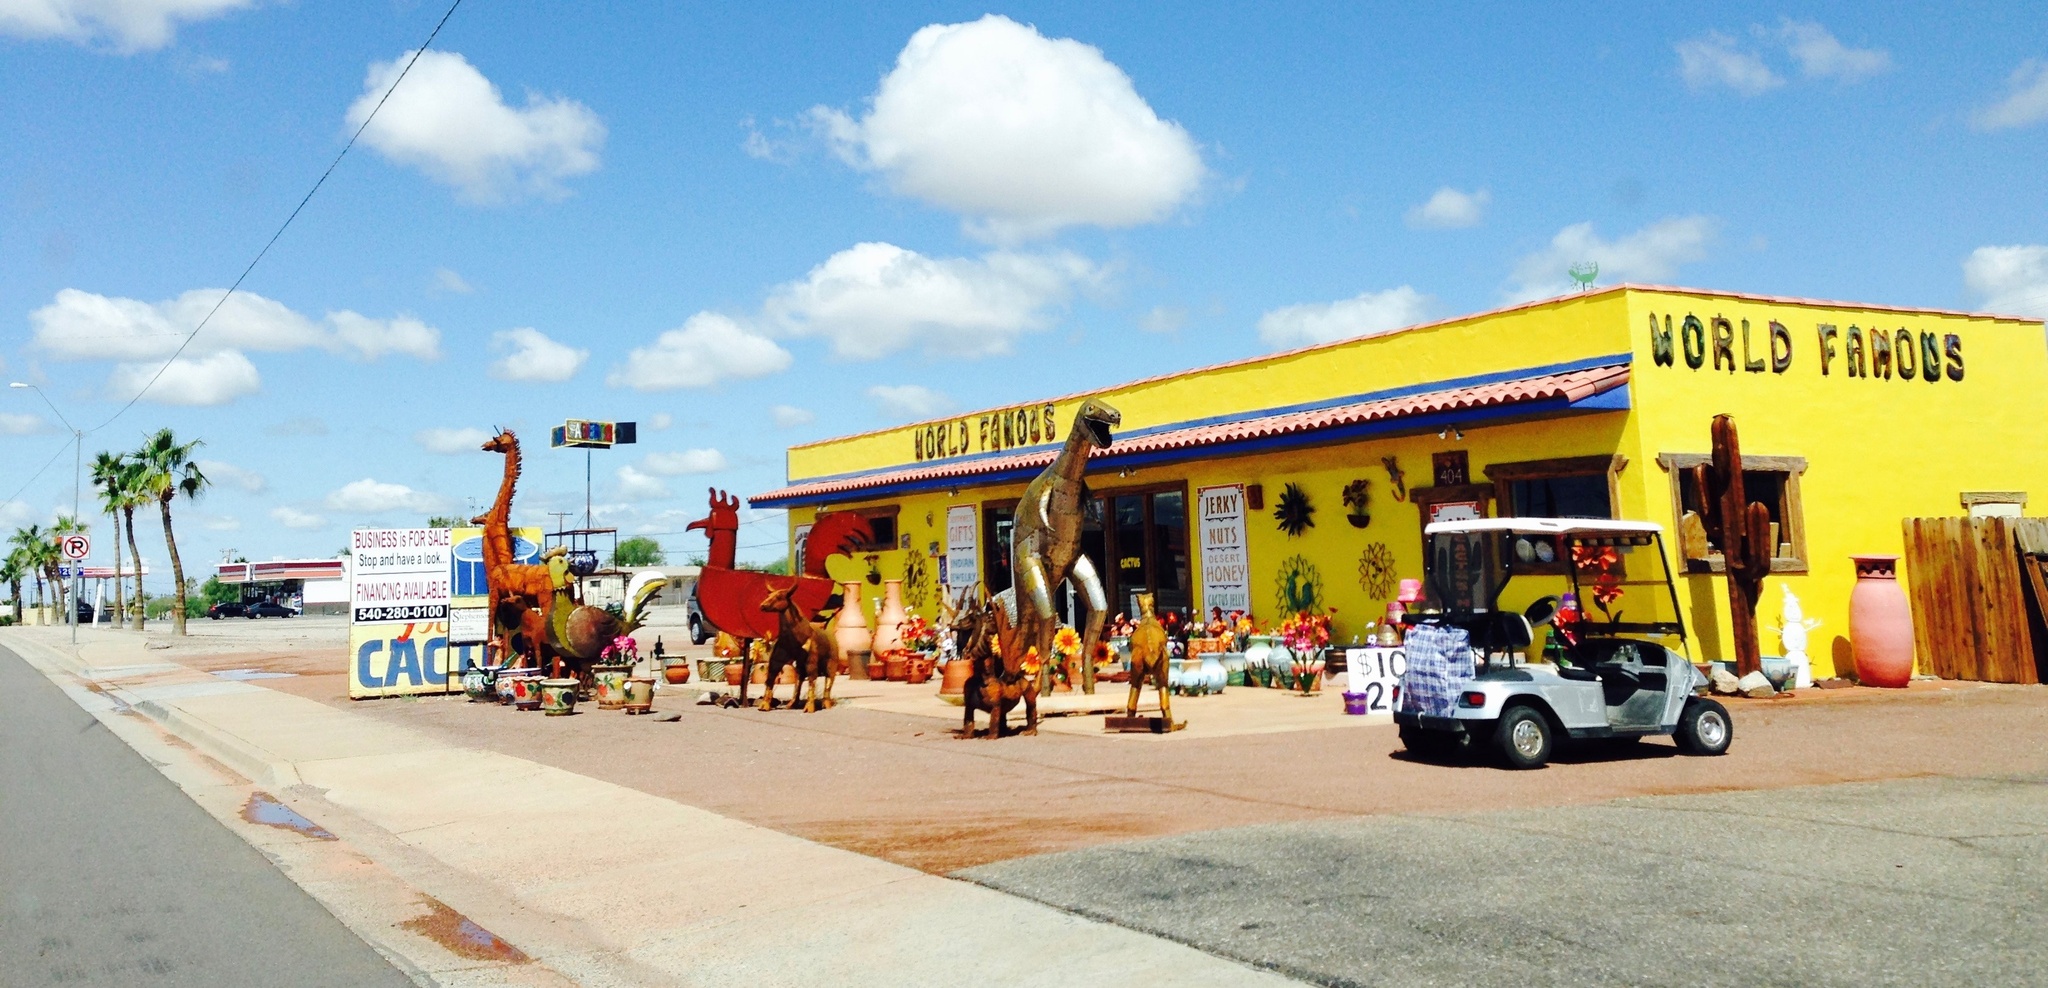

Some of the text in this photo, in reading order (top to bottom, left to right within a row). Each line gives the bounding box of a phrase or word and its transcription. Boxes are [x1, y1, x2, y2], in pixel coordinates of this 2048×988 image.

[1650, 312, 1965, 384] WORLD FAMOUS
[915, 403, 1056, 461] WORLD FAMOUS
[1440, 469, 1462, 484] 404
[1205, 494, 1237, 516] JERKY
[355, 529, 449, 549] BUSINESS is FOR SALE
[949, 525, 974, 542] GIFTS
[1209, 526, 1237, 545] NUTS
[359, 553, 377, 569] Stop
[380, 553, 394, 566] and
[396, 552, 415, 565] have
[417, 555, 422, 564] a
[1208, 553, 1240, 564] DESERT
[1206, 565, 1245, 582] HONEY
[356, 581, 447, 602] FINANCING AVAILABLE
[1207, 593, 1245, 607] CACTUS JELLY
[358, 605, 443, 620] 540-280-0100
